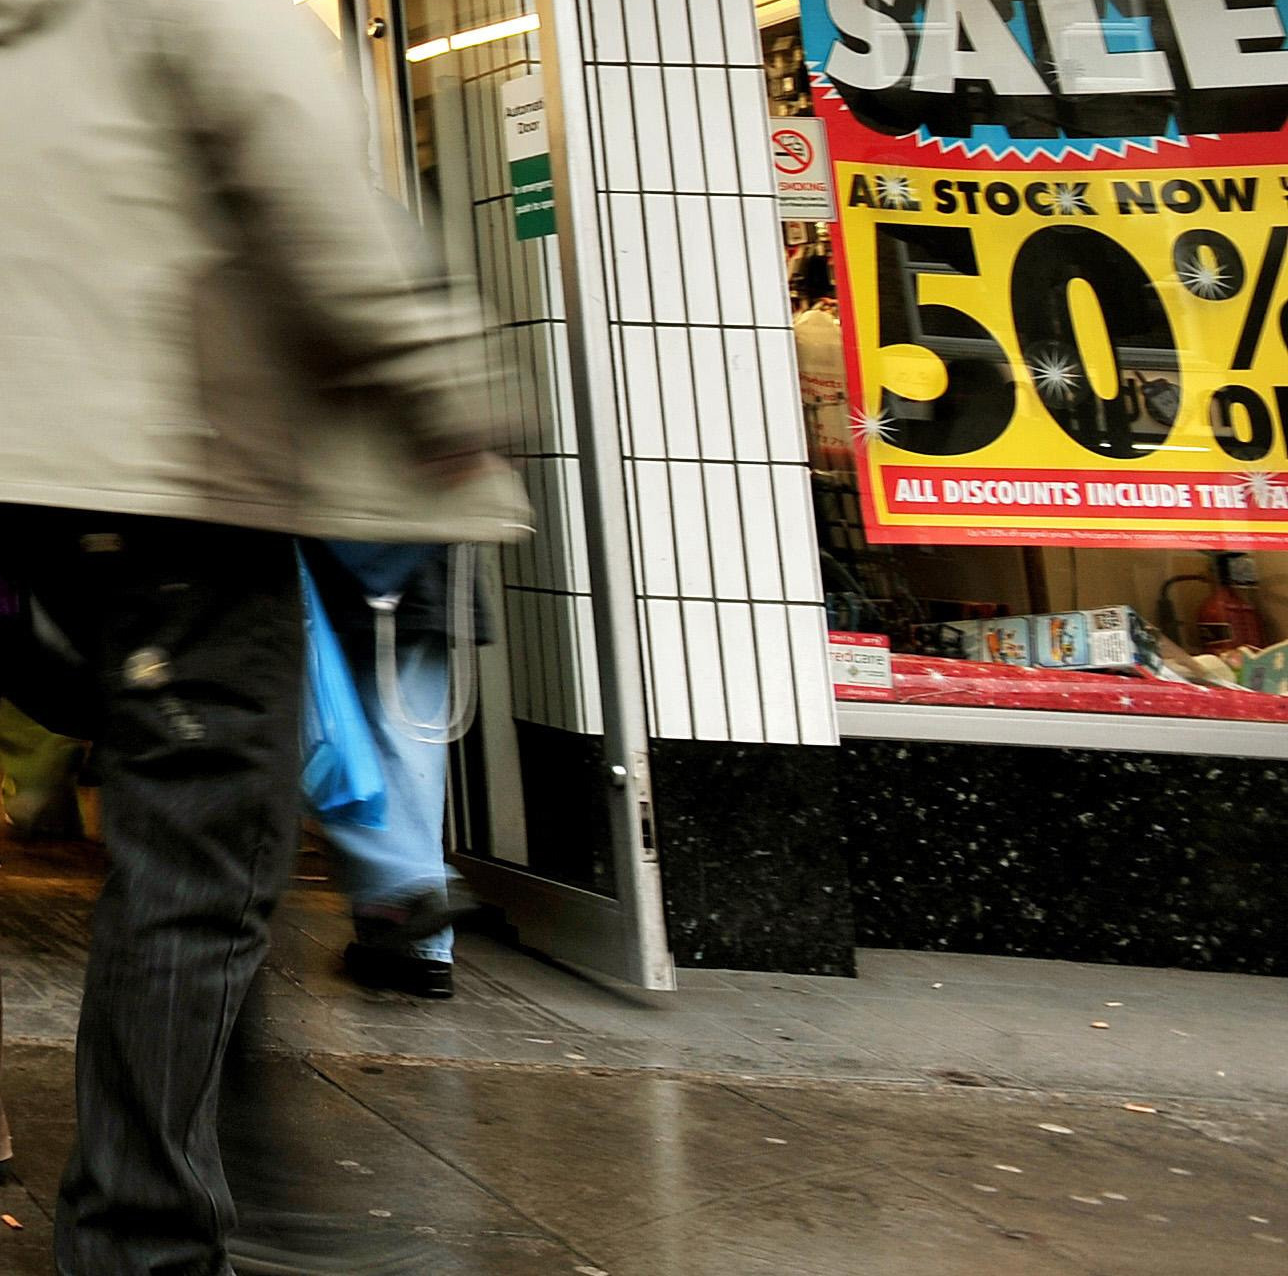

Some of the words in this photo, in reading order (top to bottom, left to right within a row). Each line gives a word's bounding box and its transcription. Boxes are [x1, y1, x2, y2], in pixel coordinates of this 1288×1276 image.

[933, 179, 1099, 216] STOCK
[1112, 177, 1260, 215] NOW
[895, 478, 938, 503] ALL
[943, 480, 1081, 507] DISCOUNTS
[1087, 482, 1192, 508] INCLUDE
[1196, 484, 1247, 509] THE
